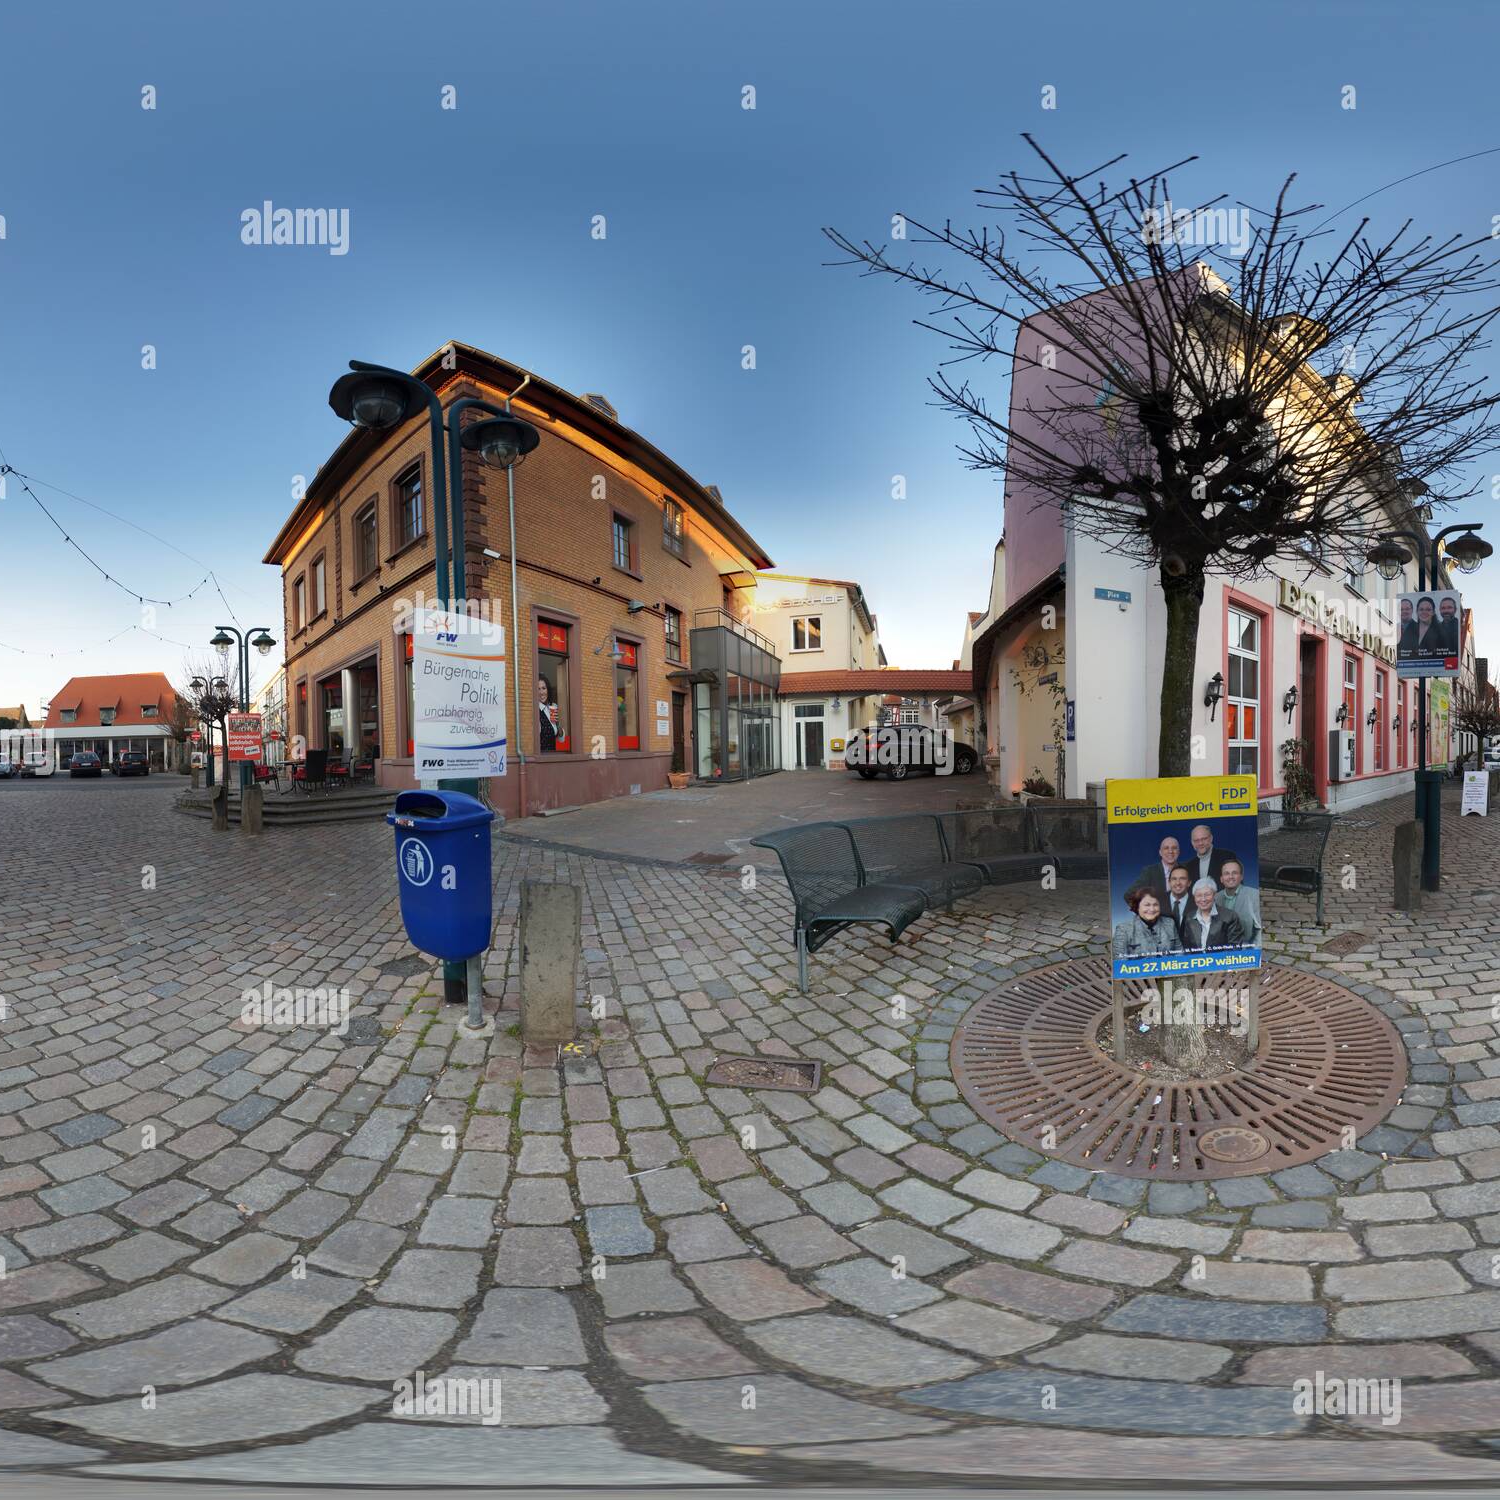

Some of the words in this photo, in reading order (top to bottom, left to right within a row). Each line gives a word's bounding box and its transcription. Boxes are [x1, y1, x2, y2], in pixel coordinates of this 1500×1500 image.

[423, 659, 490, 682] Bürgernahe
[460, 682, 499, 706] Politik
[424, 704, 484, 721] unabhängig,
[449, 723, 498, 738] zuverlässig!
[422, 759, 444, 767] FWG
[498, 756, 504, 773] 6
[1221, 787, 1248, 800] FDP
[1113, 804, 1173, 818] Erfolgreich
[1195, 801, 1214, 812] Ort
[1120, 964, 1140, 974] Am
[1142, 963, 1158, 973] 27.
[1161, 960, 1189, 971] März
[1191, 957, 1213, 968] FDP
[1216, 954, 1256, 966] wählen
